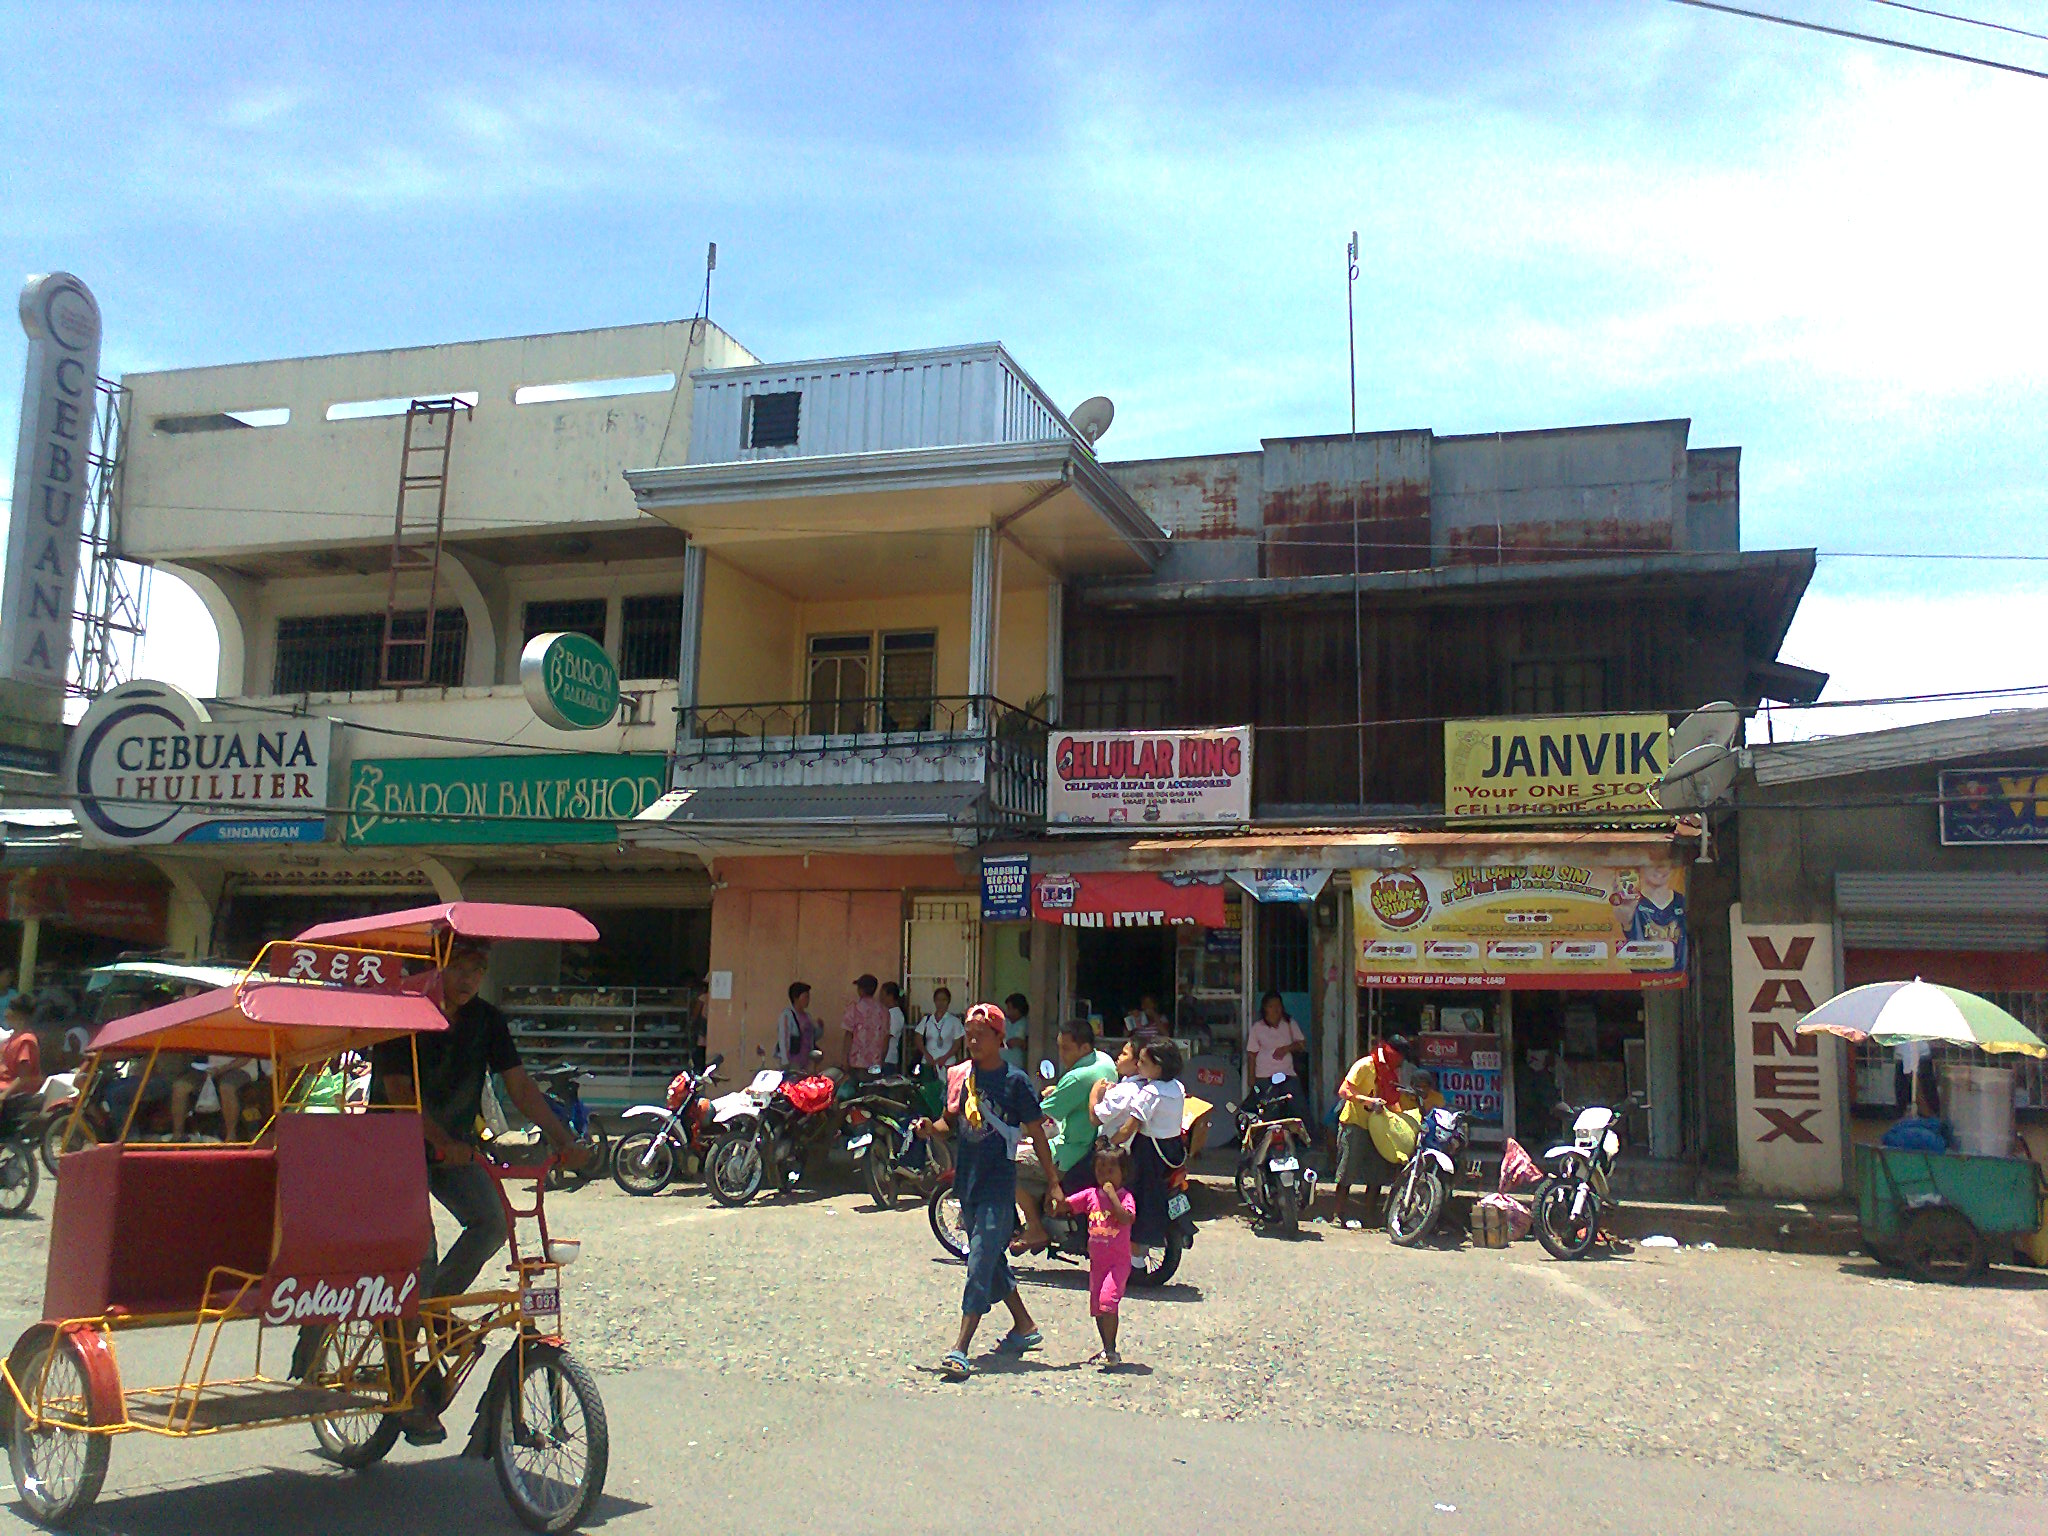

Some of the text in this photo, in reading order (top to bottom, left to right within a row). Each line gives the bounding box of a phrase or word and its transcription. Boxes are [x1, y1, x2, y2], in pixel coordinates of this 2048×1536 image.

[24, 358, 85, 671] CEBUANA
[116, 730, 318, 772] CEBUANA
[1056, 736, 1242, 781] CELLULAR KING
[1481, 731, 1663, 778] JANVIK
[116, 773, 313, 800] LHUILLIER
[1064, 781, 1119, 791] CELLPHONE
[1121, 780, 1155, 790] REPAIR
[1528, 784, 1580, 798] ONE
[1592, 782, 1646, 796] STO
[218, 826, 299, 839] SINDANGAN
[987, 884, 1023, 895] STATION
[1559, 867, 1592, 885] SIM
[288, 949, 321, 979] R
[354, 955, 386, 985] R
[1747, 936, 1823, 1144] VANEX
[1443, 1072, 1485, 1091] LOAD
[264, 1272, 417, 1324] Sakay Na!
